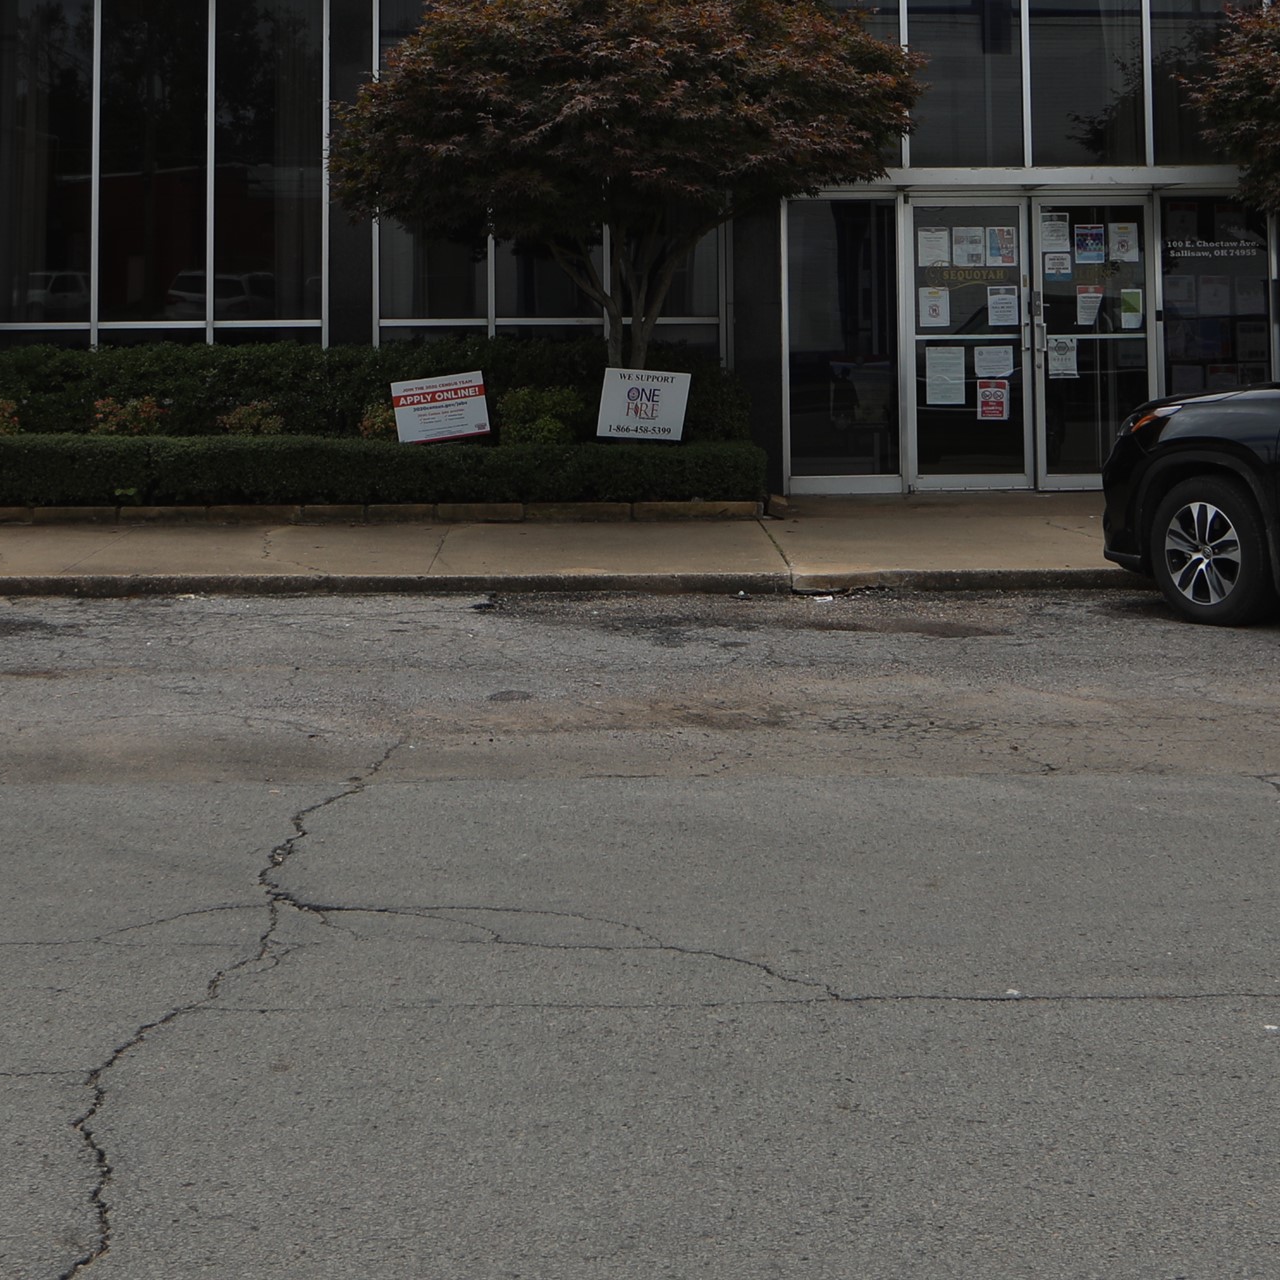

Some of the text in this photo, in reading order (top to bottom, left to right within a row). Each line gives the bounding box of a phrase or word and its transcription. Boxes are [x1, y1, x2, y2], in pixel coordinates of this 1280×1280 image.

[1170, 250, 1211, 258] Sallisaw,
[943, 271, 1004, 281] SEQUOYAH
[635, 374, 676, 383] SUPPORT
[400, 387, 479, 405] APPLY ONLINE!
[627, 387, 661, 402] ONE
[626, 402, 659, 418] FIRE
[609, 425, 671, 434] 1-866-458-5399
